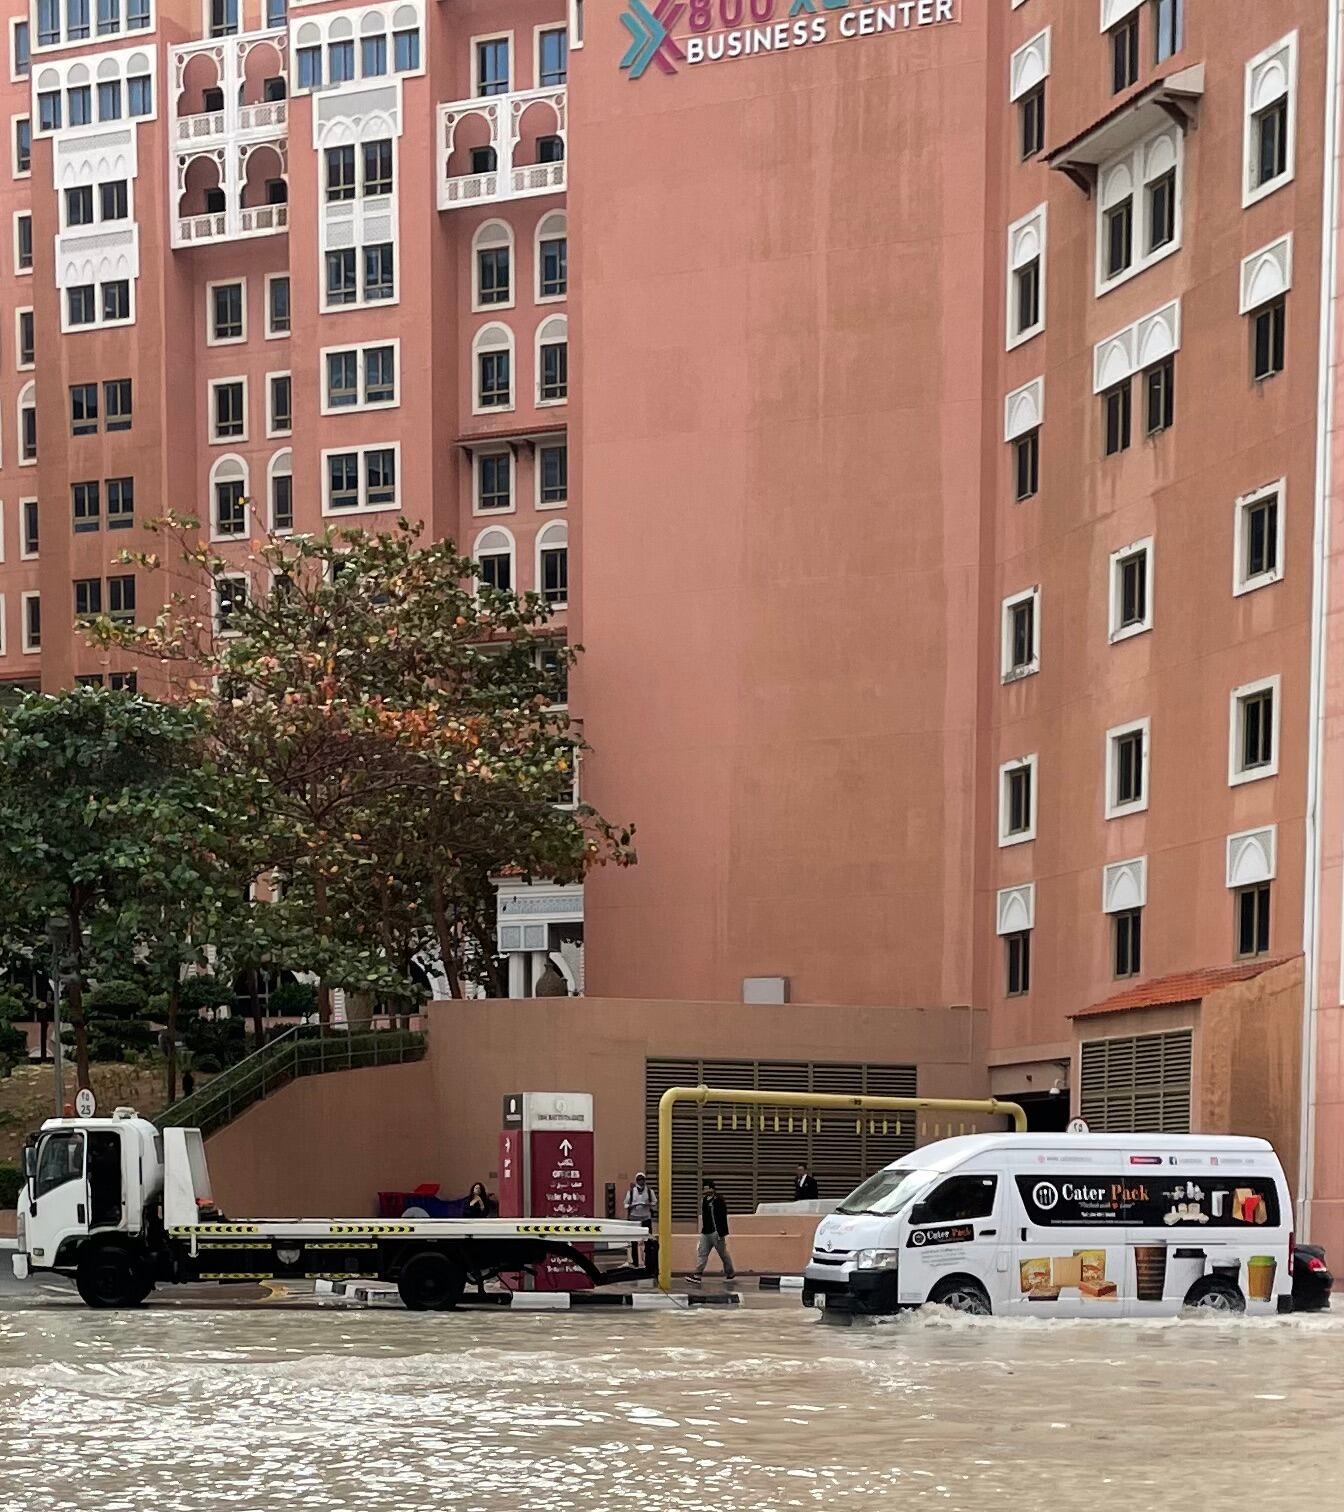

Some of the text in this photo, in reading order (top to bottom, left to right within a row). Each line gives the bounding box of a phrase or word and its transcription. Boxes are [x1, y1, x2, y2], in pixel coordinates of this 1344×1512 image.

[687, 17, 827, 64] BUSINESS
[839, 0, 954, 37] CENTER
[1062, 1184, 1149, 1201] Cater Pack
